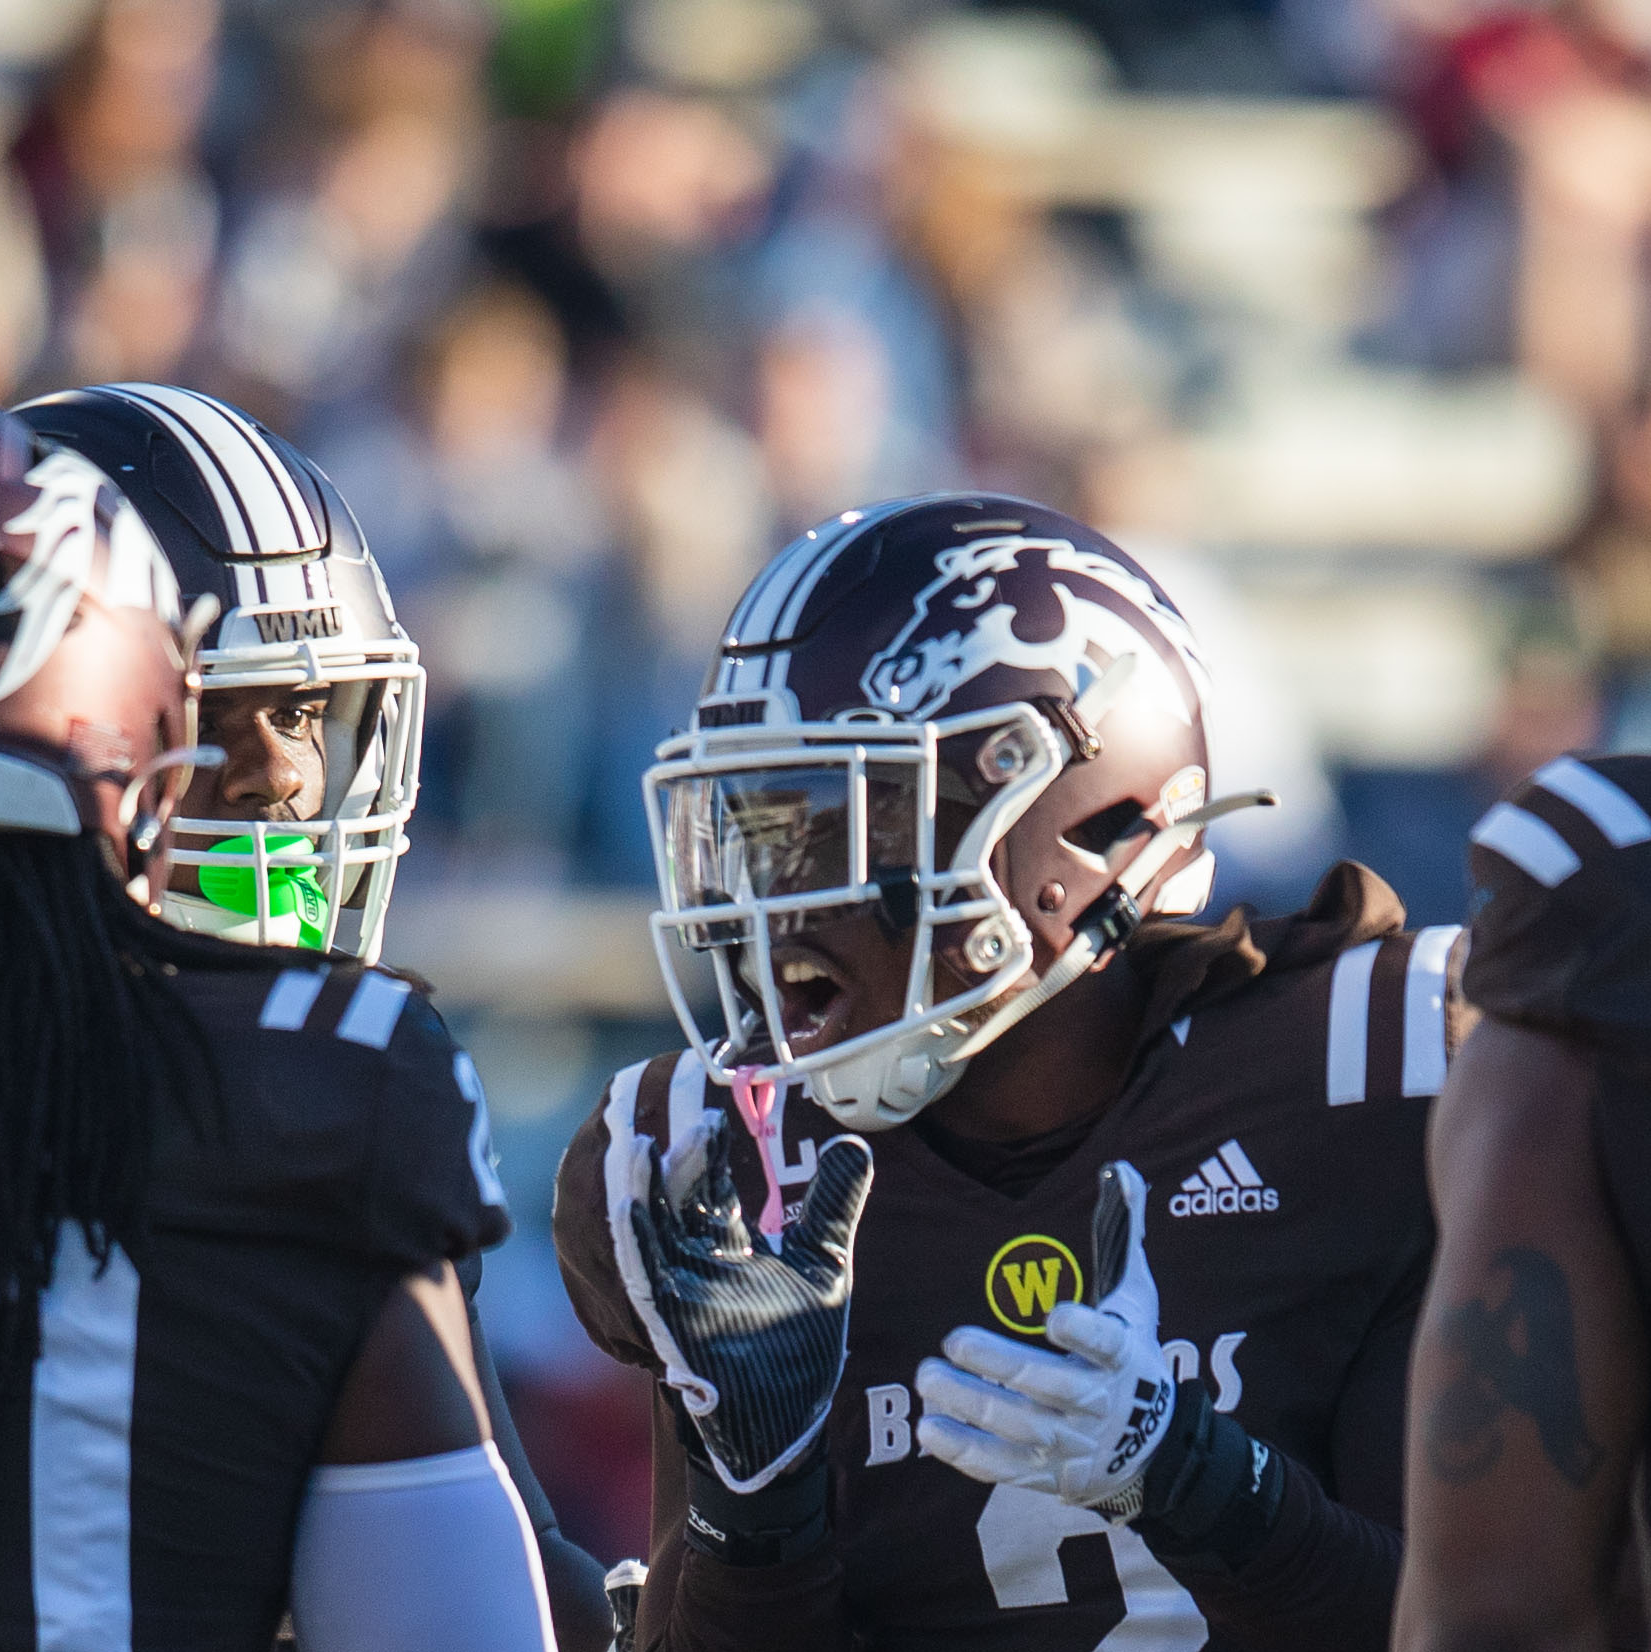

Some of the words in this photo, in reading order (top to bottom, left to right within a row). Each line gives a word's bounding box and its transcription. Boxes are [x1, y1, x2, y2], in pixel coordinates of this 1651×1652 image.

[253, 606, 343, 644] WMU
[1168, 1186, 1279, 1218] adidas
[1002, 1257, 1061, 1317] W
